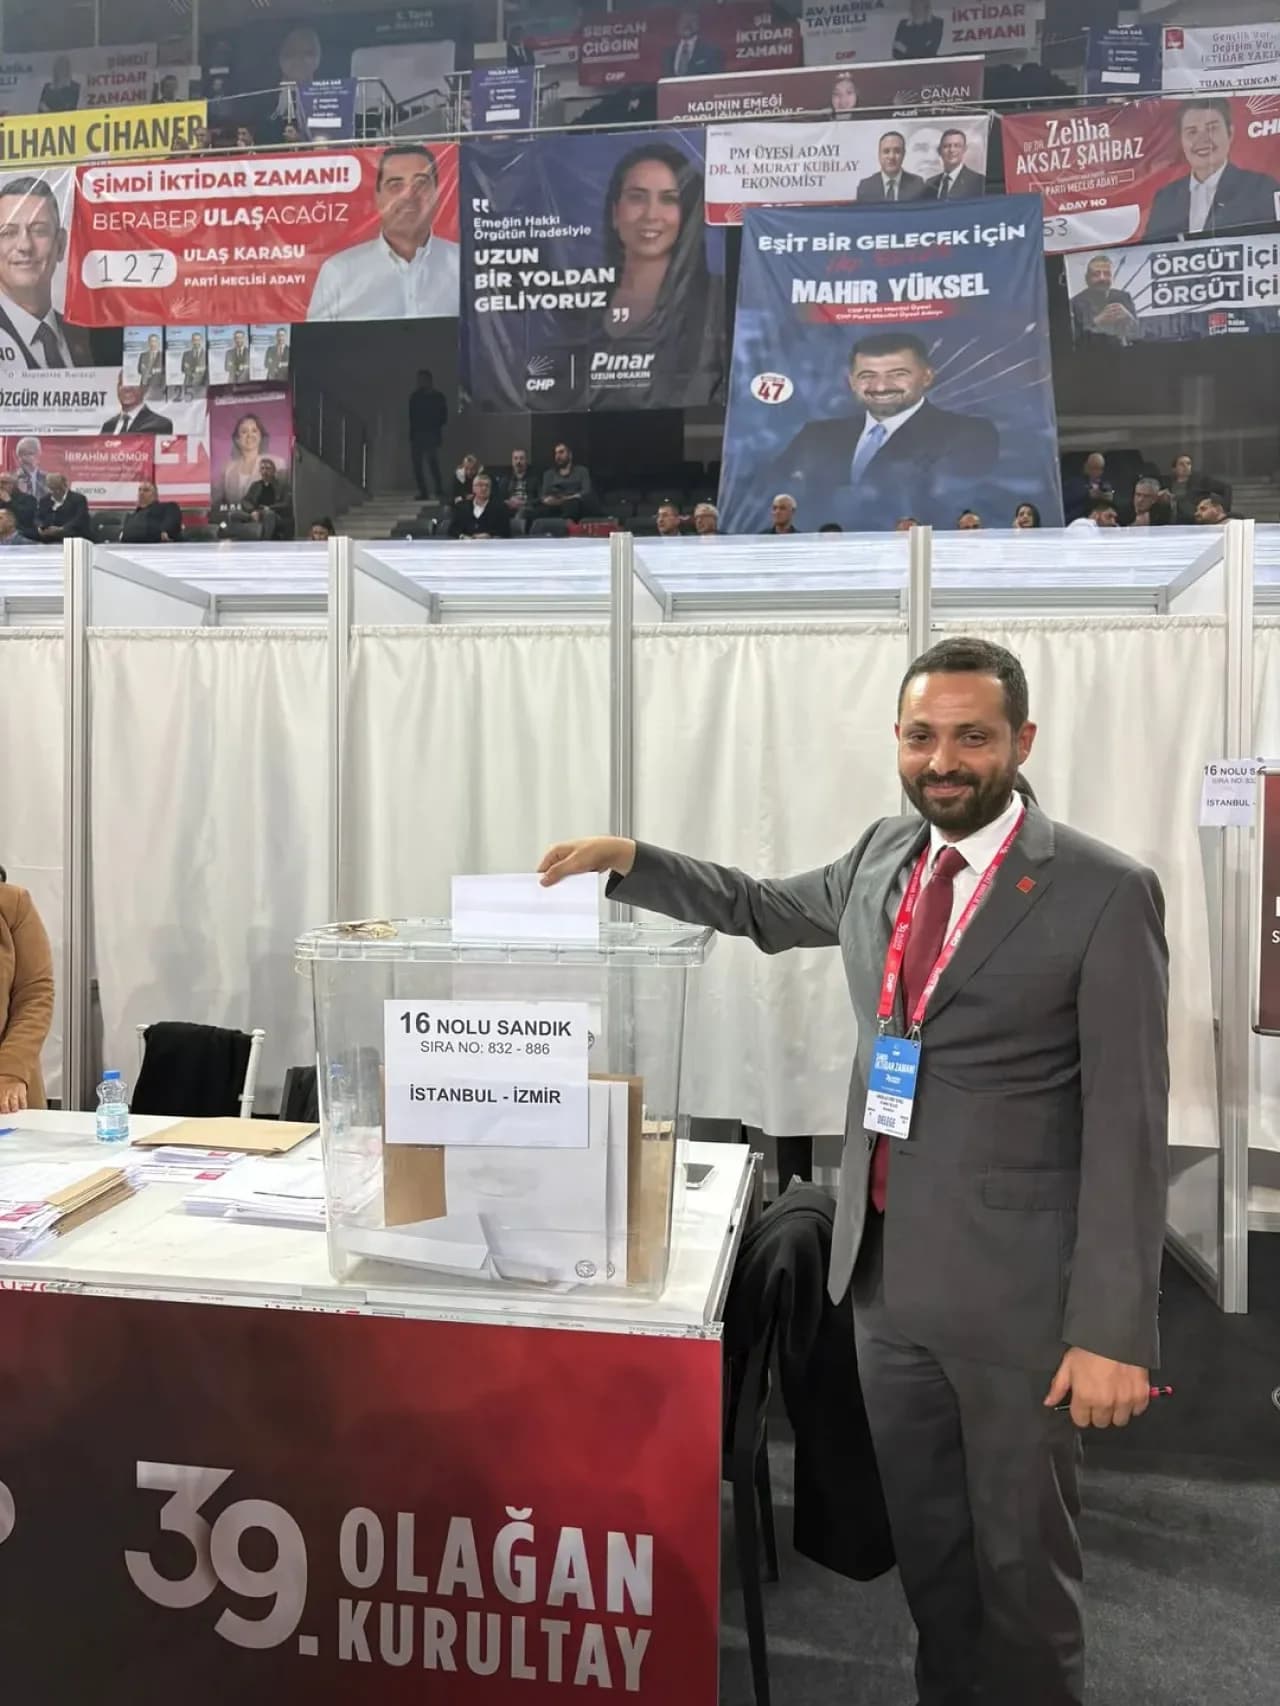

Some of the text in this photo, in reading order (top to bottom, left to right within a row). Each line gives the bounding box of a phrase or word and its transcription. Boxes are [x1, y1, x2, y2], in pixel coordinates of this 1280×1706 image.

[952, 4, 1025, 23] İKTİDAR
[952, 24, 1025, 42] ZAMANI
[920, 85, 970, 99] CANAN
[0, 114, 202, 160] İLHAN CİHANER
[1046, 117, 1110, 149] Zeliha
[1247, 118, 1280, 138] CH
[729, 144, 840, 160] PM ÜYESİ ADAYI
[1016, 137, 1145, 175] AKSAZ ŞAHBAZ
[709, 164, 731, 175] DR.
[752, 162, 800, 174] MURAT
[92, 167, 349, 197] ŞİMDİ İKTİDAR ZAMANI!
[741, 174, 826, 189] EKONOMİST
[1058, 198, 1107, 211] ADAY NO
[93, 202, 349, 231] BERABER ULAŞACAĞIZ
[473, 215, 560, 230] Emeğin Hakkı
[474, 225, 592, 241] Örgütün İradesiyle
[758, 222, 1025, 255] EŞİT BİR GELECEK İÇİN
[184, 245, 306, 264] ULAŞ KARASU
[474, 248, 539, 265] UZUN
[1152, 248, 1240, 275] ÖRGÜT
[184, 274, 306, 287] PARTİ MECLİSİ ADAYI
[474, 267, 616, 290] BİR YOLDAN
[888, 272, 990, 301] YÜKSEL
[1153, 277, 1240, 305] ÖRGÜT
[474, 291, 607, 312] GELİYORUZ
[590, 351, 655, 371] Pınar
[526, 378, 555, 391] CHP
[758, 382, 785, 400] 47
[0, 388, 107, 407] ÖZGÜR KARABAT
[1204, 765, 1217, 776] 16
[1220, 767, 1247, 776] NOLU
[400, 1011, 571, 1036] 16 NOLU SANDIK
[420, 1041, 455, 1053] SIRA
[459, 1041, 484, 1054] NO:
[488, 1042, 512, 1054] 832
[525, 1043, 550, 1054] 886
[410, 1084, 497, 1103] İSTANBUL
[514, 1086, 561, 1104] İZMİR
[124, 1460, 318, 1657] 39.
[339, 1505, 653, 1616] OLAĞAN
[338, 1599, 652, 1692] KURULTAY
